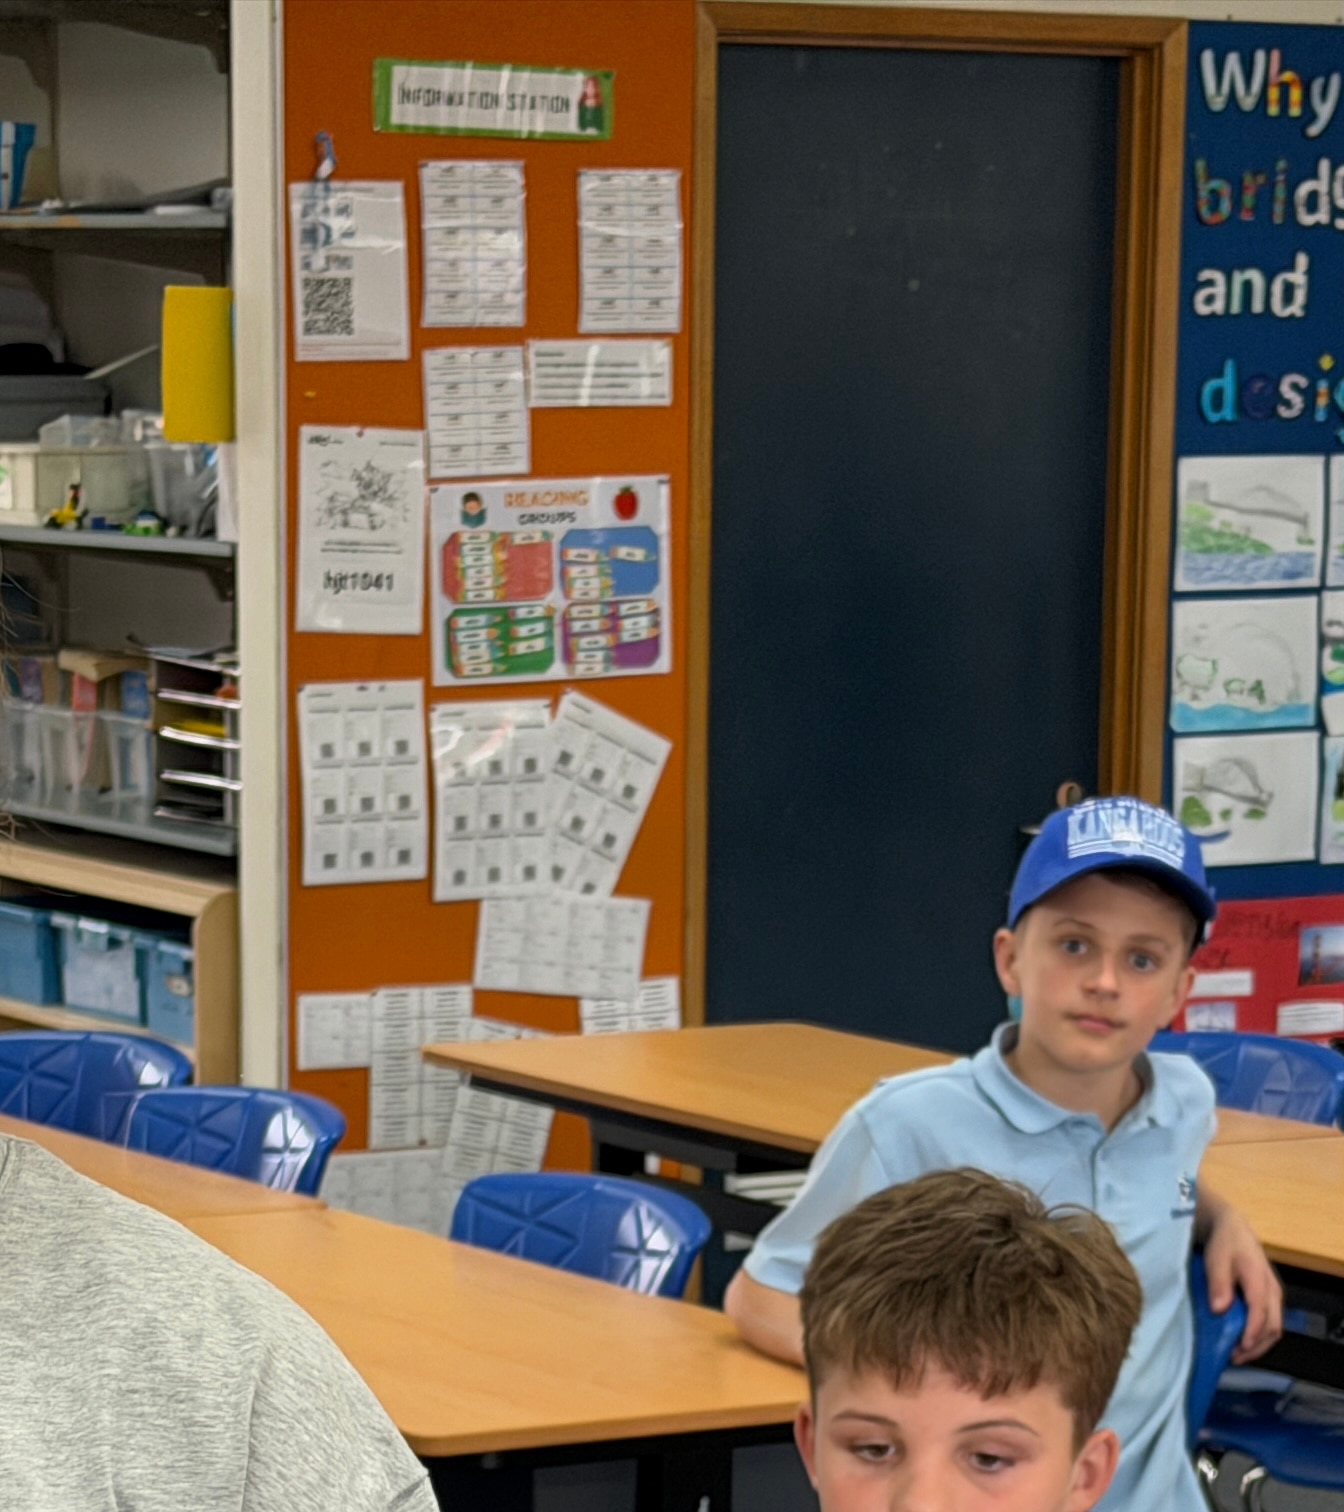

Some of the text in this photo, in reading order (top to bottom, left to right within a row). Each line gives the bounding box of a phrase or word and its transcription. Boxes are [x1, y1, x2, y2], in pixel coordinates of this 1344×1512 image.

[398, 83, 570, 114] INFORMATION STATION
[1201, 48, 1342, 138] Why
[1193, 250, 1309, 317] and
